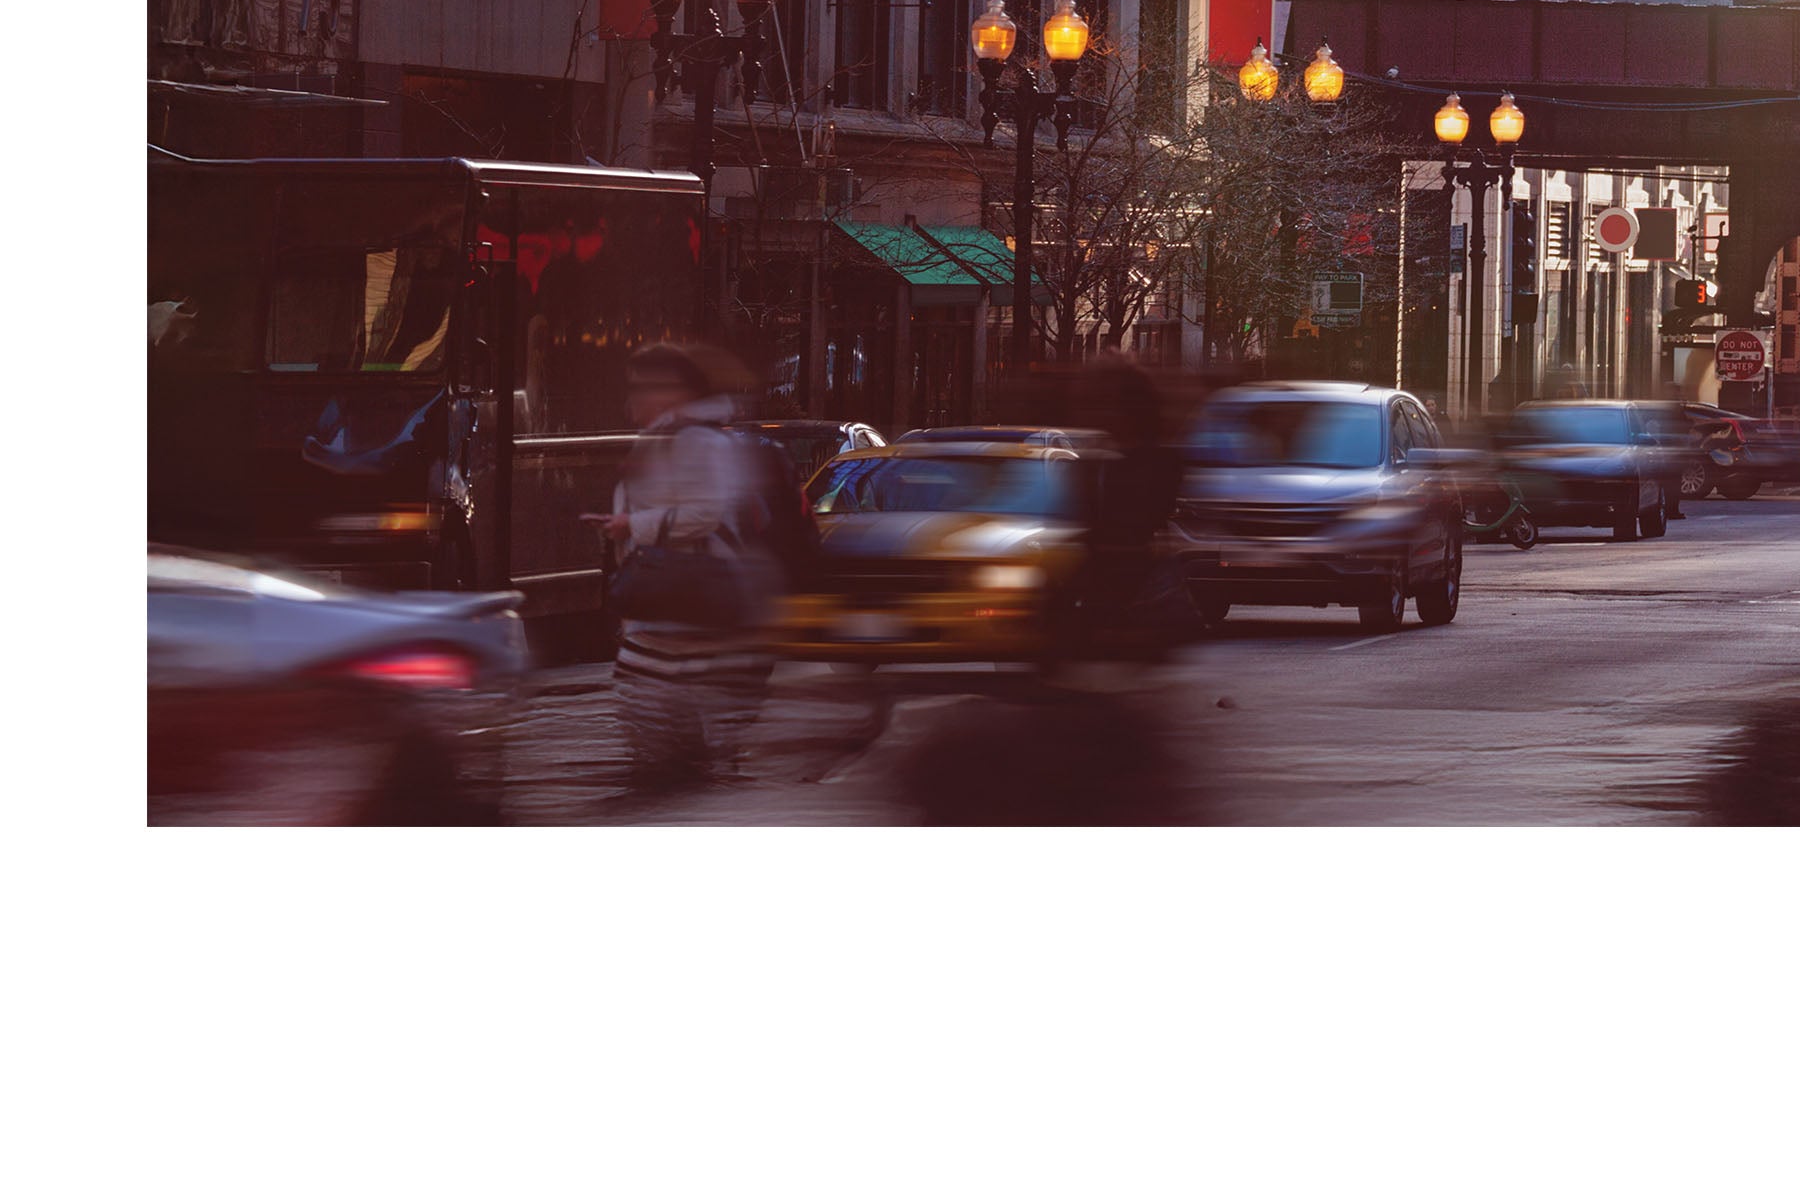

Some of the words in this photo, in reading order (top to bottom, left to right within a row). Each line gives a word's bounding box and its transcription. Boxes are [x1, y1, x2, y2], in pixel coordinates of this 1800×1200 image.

[1697, 284, 1706, 303] 3
[1722, 341, 1735, 349] DO
[1740, 341, 1758, 349] NOT
[1725, 362, 1754, 370] ENTER
